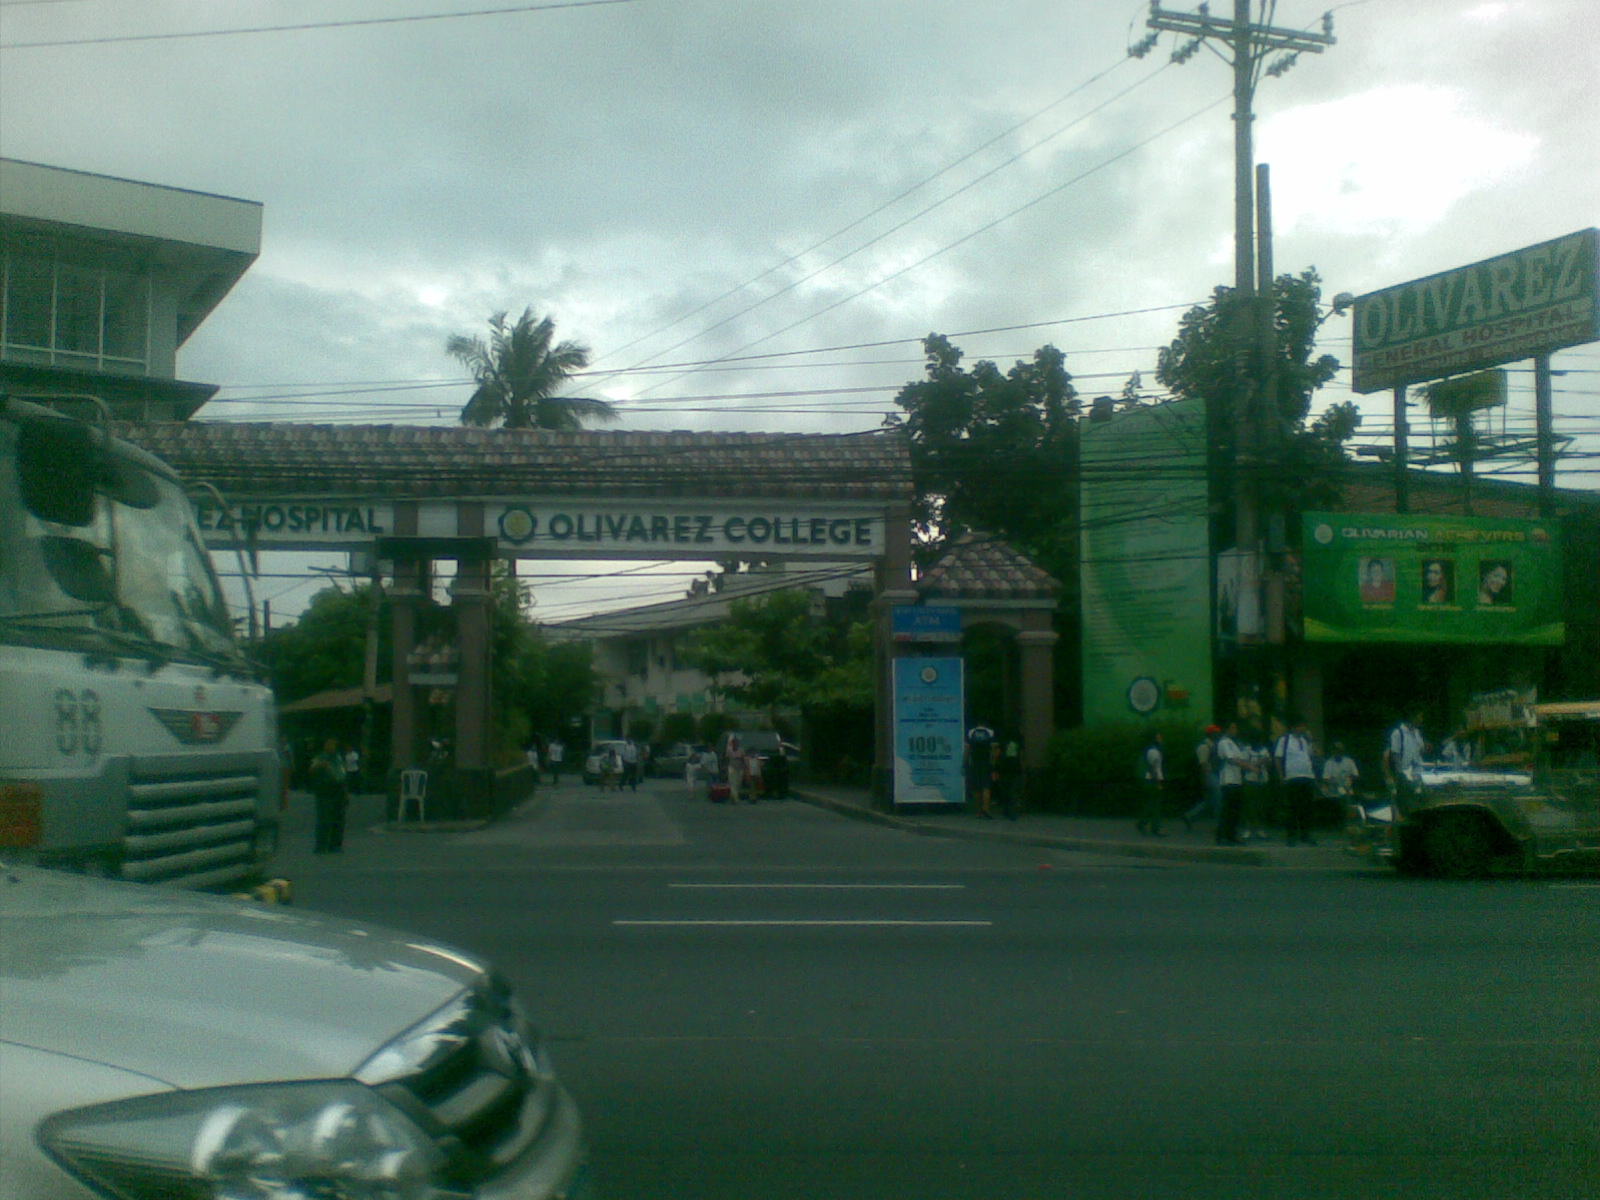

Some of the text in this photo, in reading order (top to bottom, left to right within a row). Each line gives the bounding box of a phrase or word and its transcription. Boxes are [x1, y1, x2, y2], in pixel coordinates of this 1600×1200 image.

[1360, 234, 1588, 347] OLIVAREZ
[1359, 302, 1579, 370] GENERAL HOSPITAL
[242, 505, 383, 534] HOSPITAL
[549, 513, 872, 546] OLIVAREZ COLLEGE
[1341, 526, 1428, 540] OLIVARIAN
[908, 735, 952, 754] 100%
